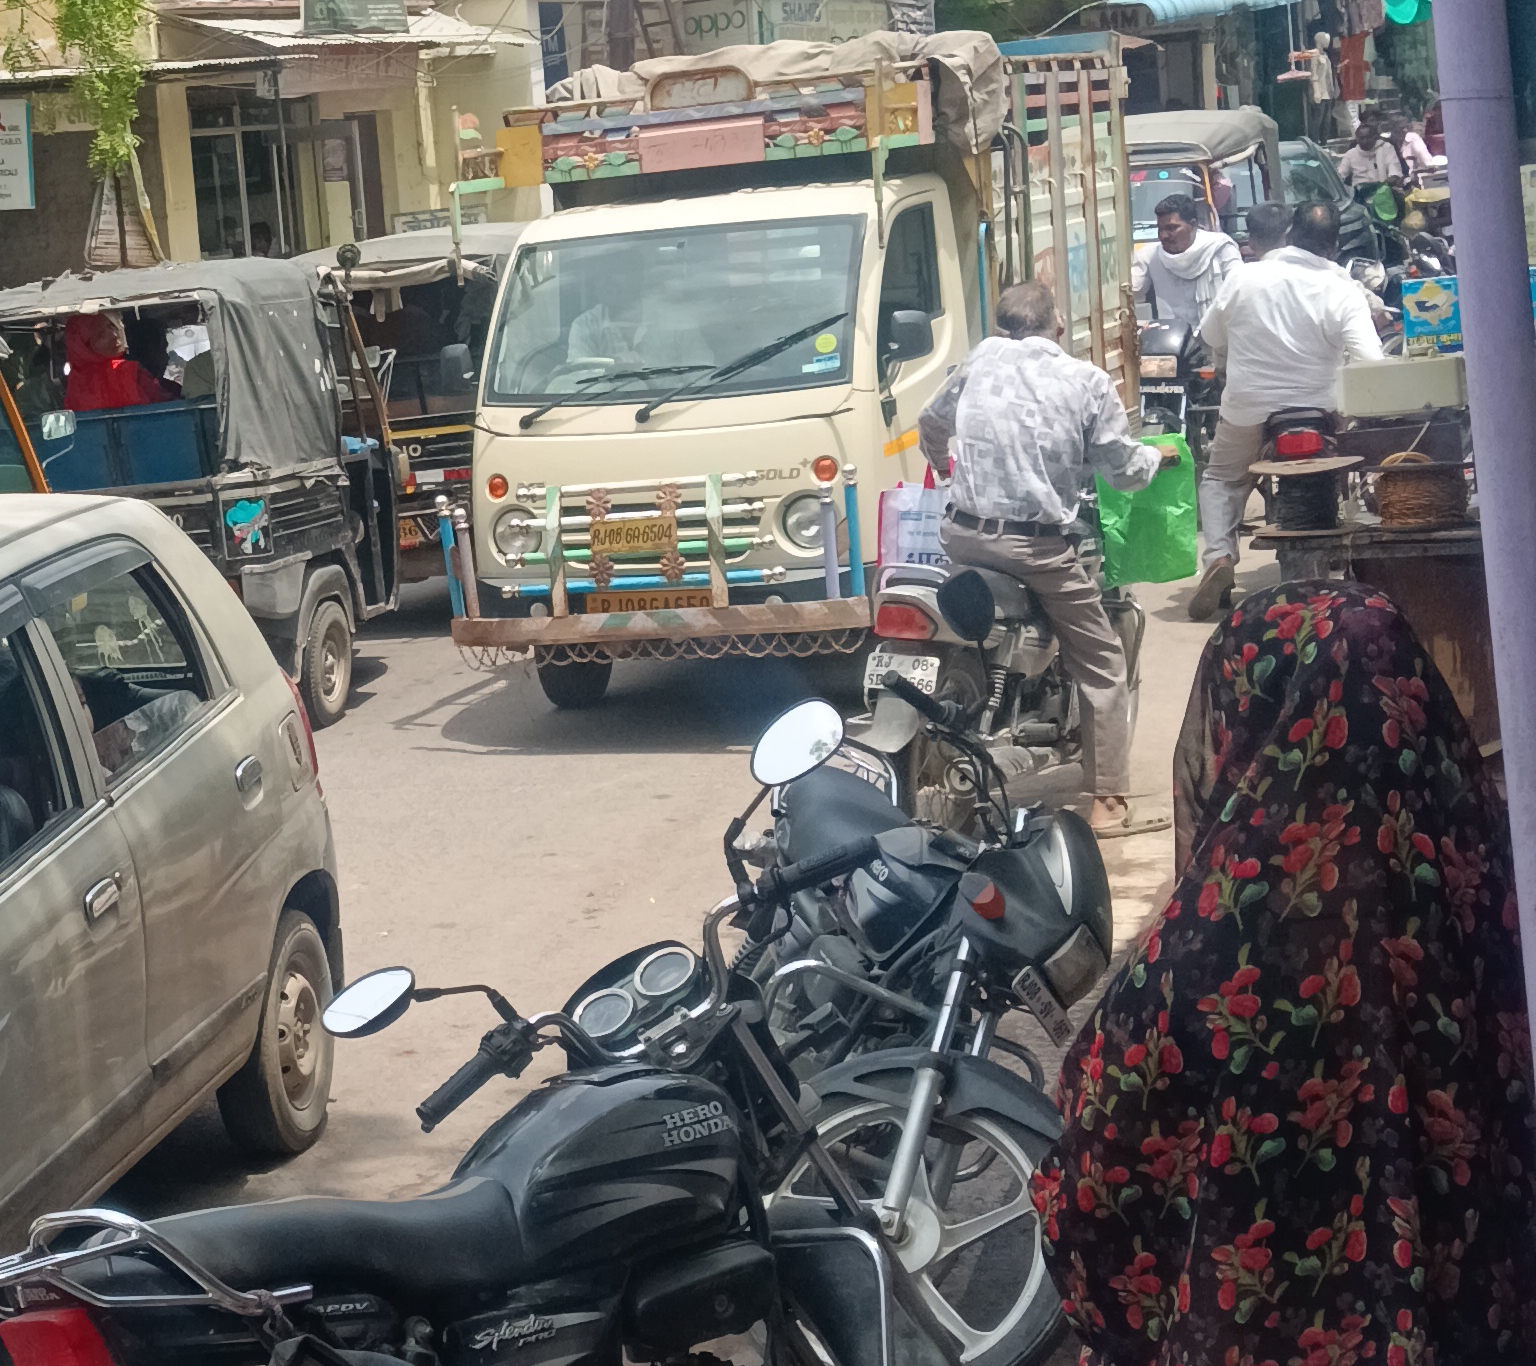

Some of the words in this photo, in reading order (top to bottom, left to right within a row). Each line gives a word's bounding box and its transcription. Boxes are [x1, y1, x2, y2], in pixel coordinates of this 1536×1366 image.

[684, 10, 745, 41] oppo
[663, 1100, 723, 1129] HERO
[661, 1115, 735, 1147] HONDA
